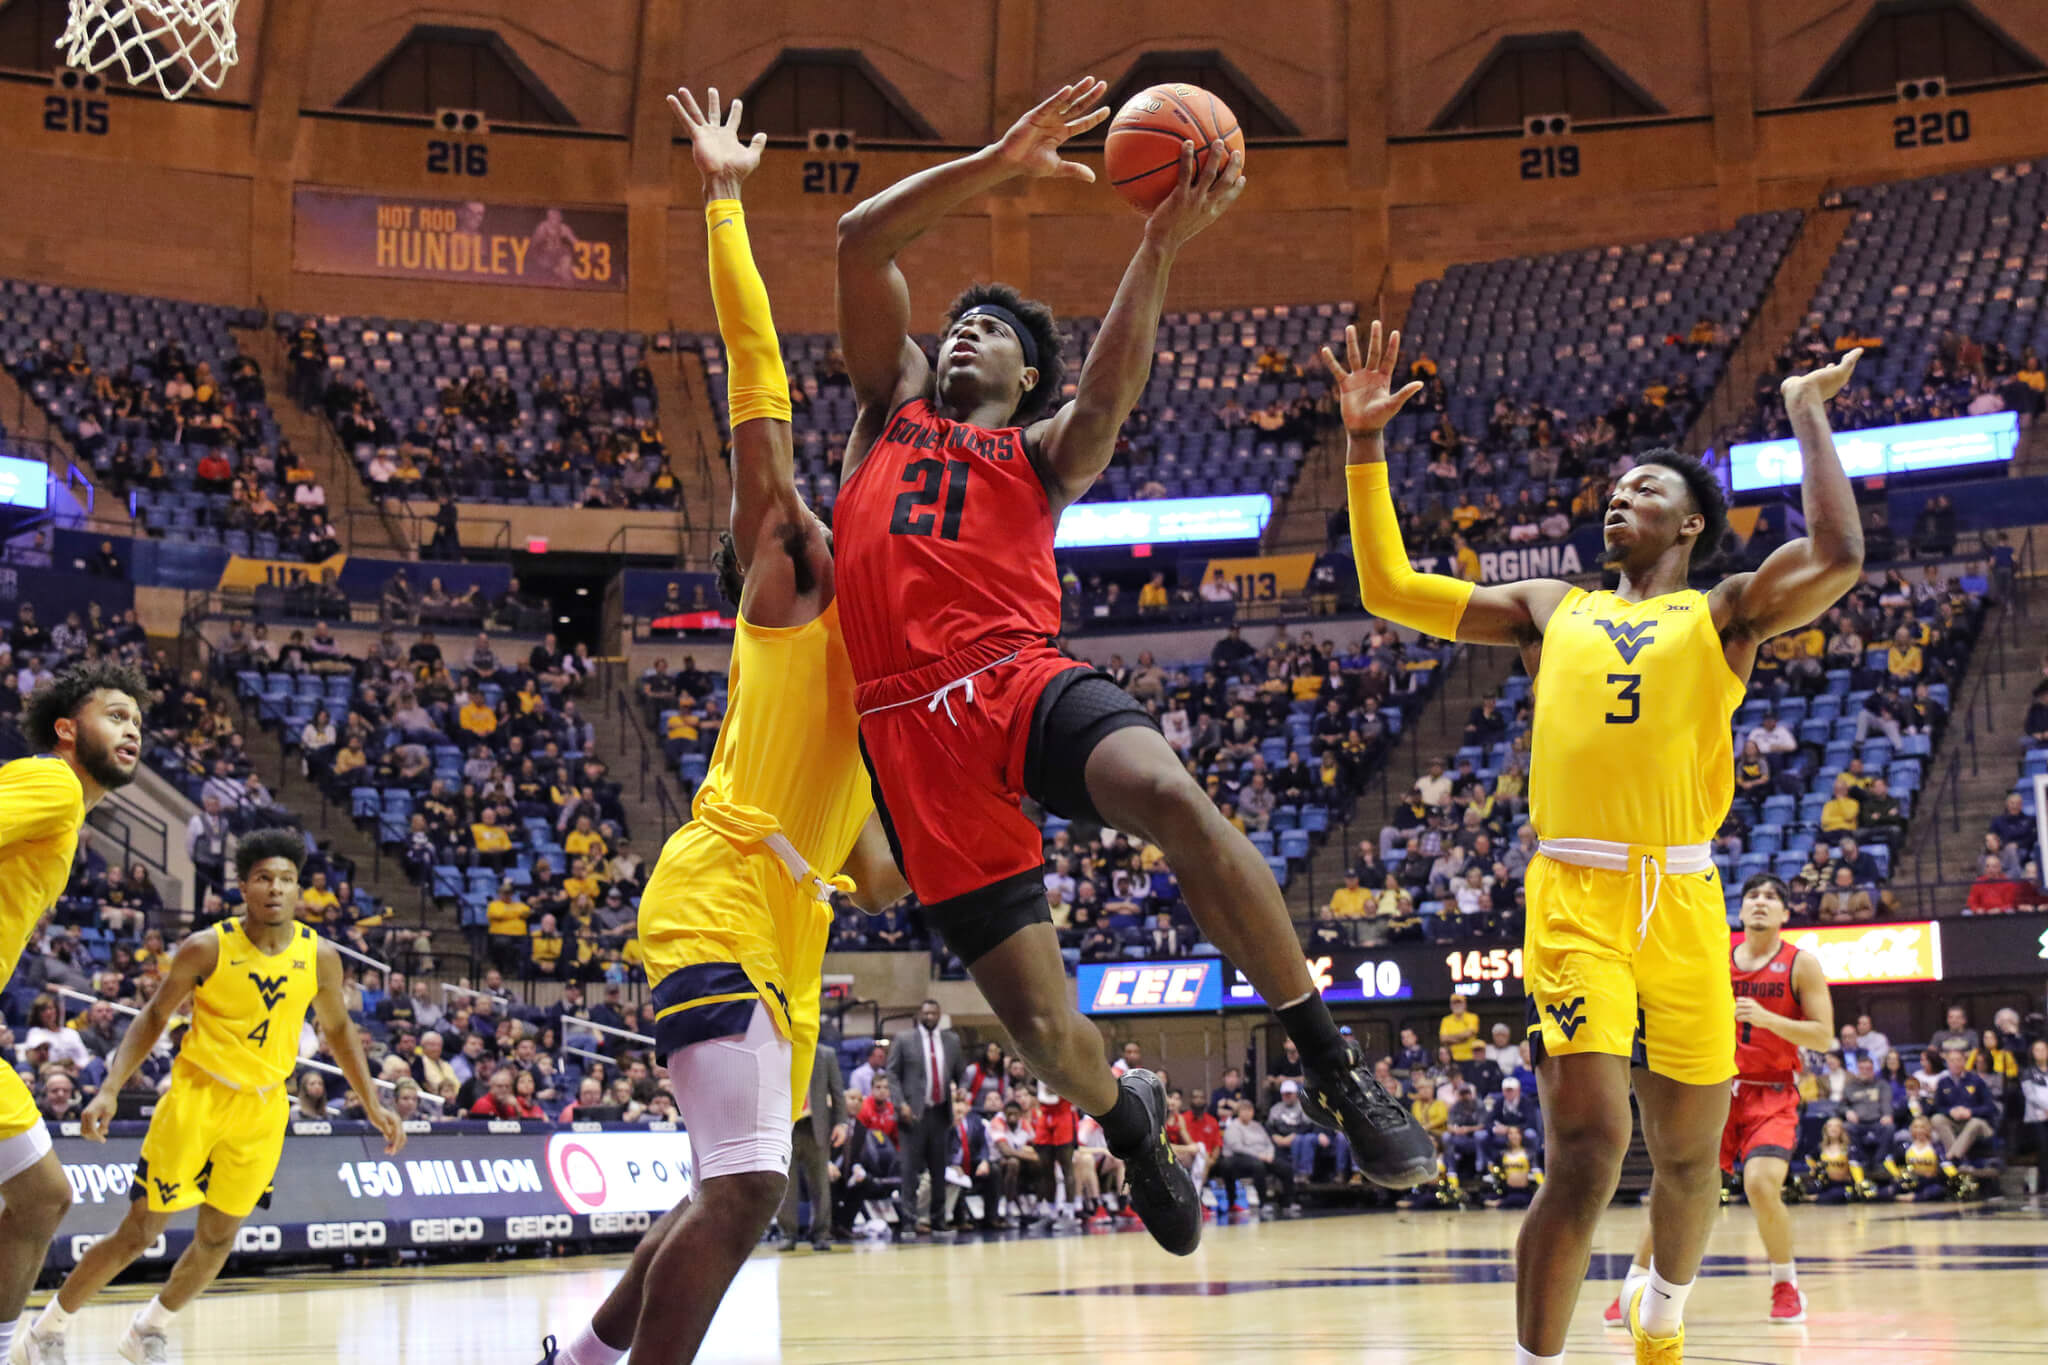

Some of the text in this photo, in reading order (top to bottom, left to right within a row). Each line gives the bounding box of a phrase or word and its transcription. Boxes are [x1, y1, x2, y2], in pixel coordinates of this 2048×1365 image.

[44, 96, 109, 136] 215
[1893, 110, 1970, 149] 220
[427, 140, 488, 177] 216
[1521, 146, 1579, 179] 219
[803, 162, 860, 194] 217
[377, 205, 457, 232] HOT ROD
[377, 229, 531, 276] HUNDLEY
[572, 241, 611, 281] 33
[885, 417, 1014, 461] GOVENORS
[889, 458, 970, 541] 21
[1234, 572, 1276, 601] 113
[1605, 673, 1641, 724] 3
[1355, 960, 1401, 997] 10
[1446, 948, 1524, 982] 14:51
[1094, 965, 1208, 1009] CEC
[1733, 980, 1785, 998] ERNORS
[247, 1019, 271, 1049] 4
[337, 1158, 543, 1198] 150 MILLION
[307, 1221, 387, 1249] GEICO
[411, 1217, 484, 1242] GEICO
[506, 1213, 573, 1240] GEICO
[590, 1212, 650, 1235] GEICO
